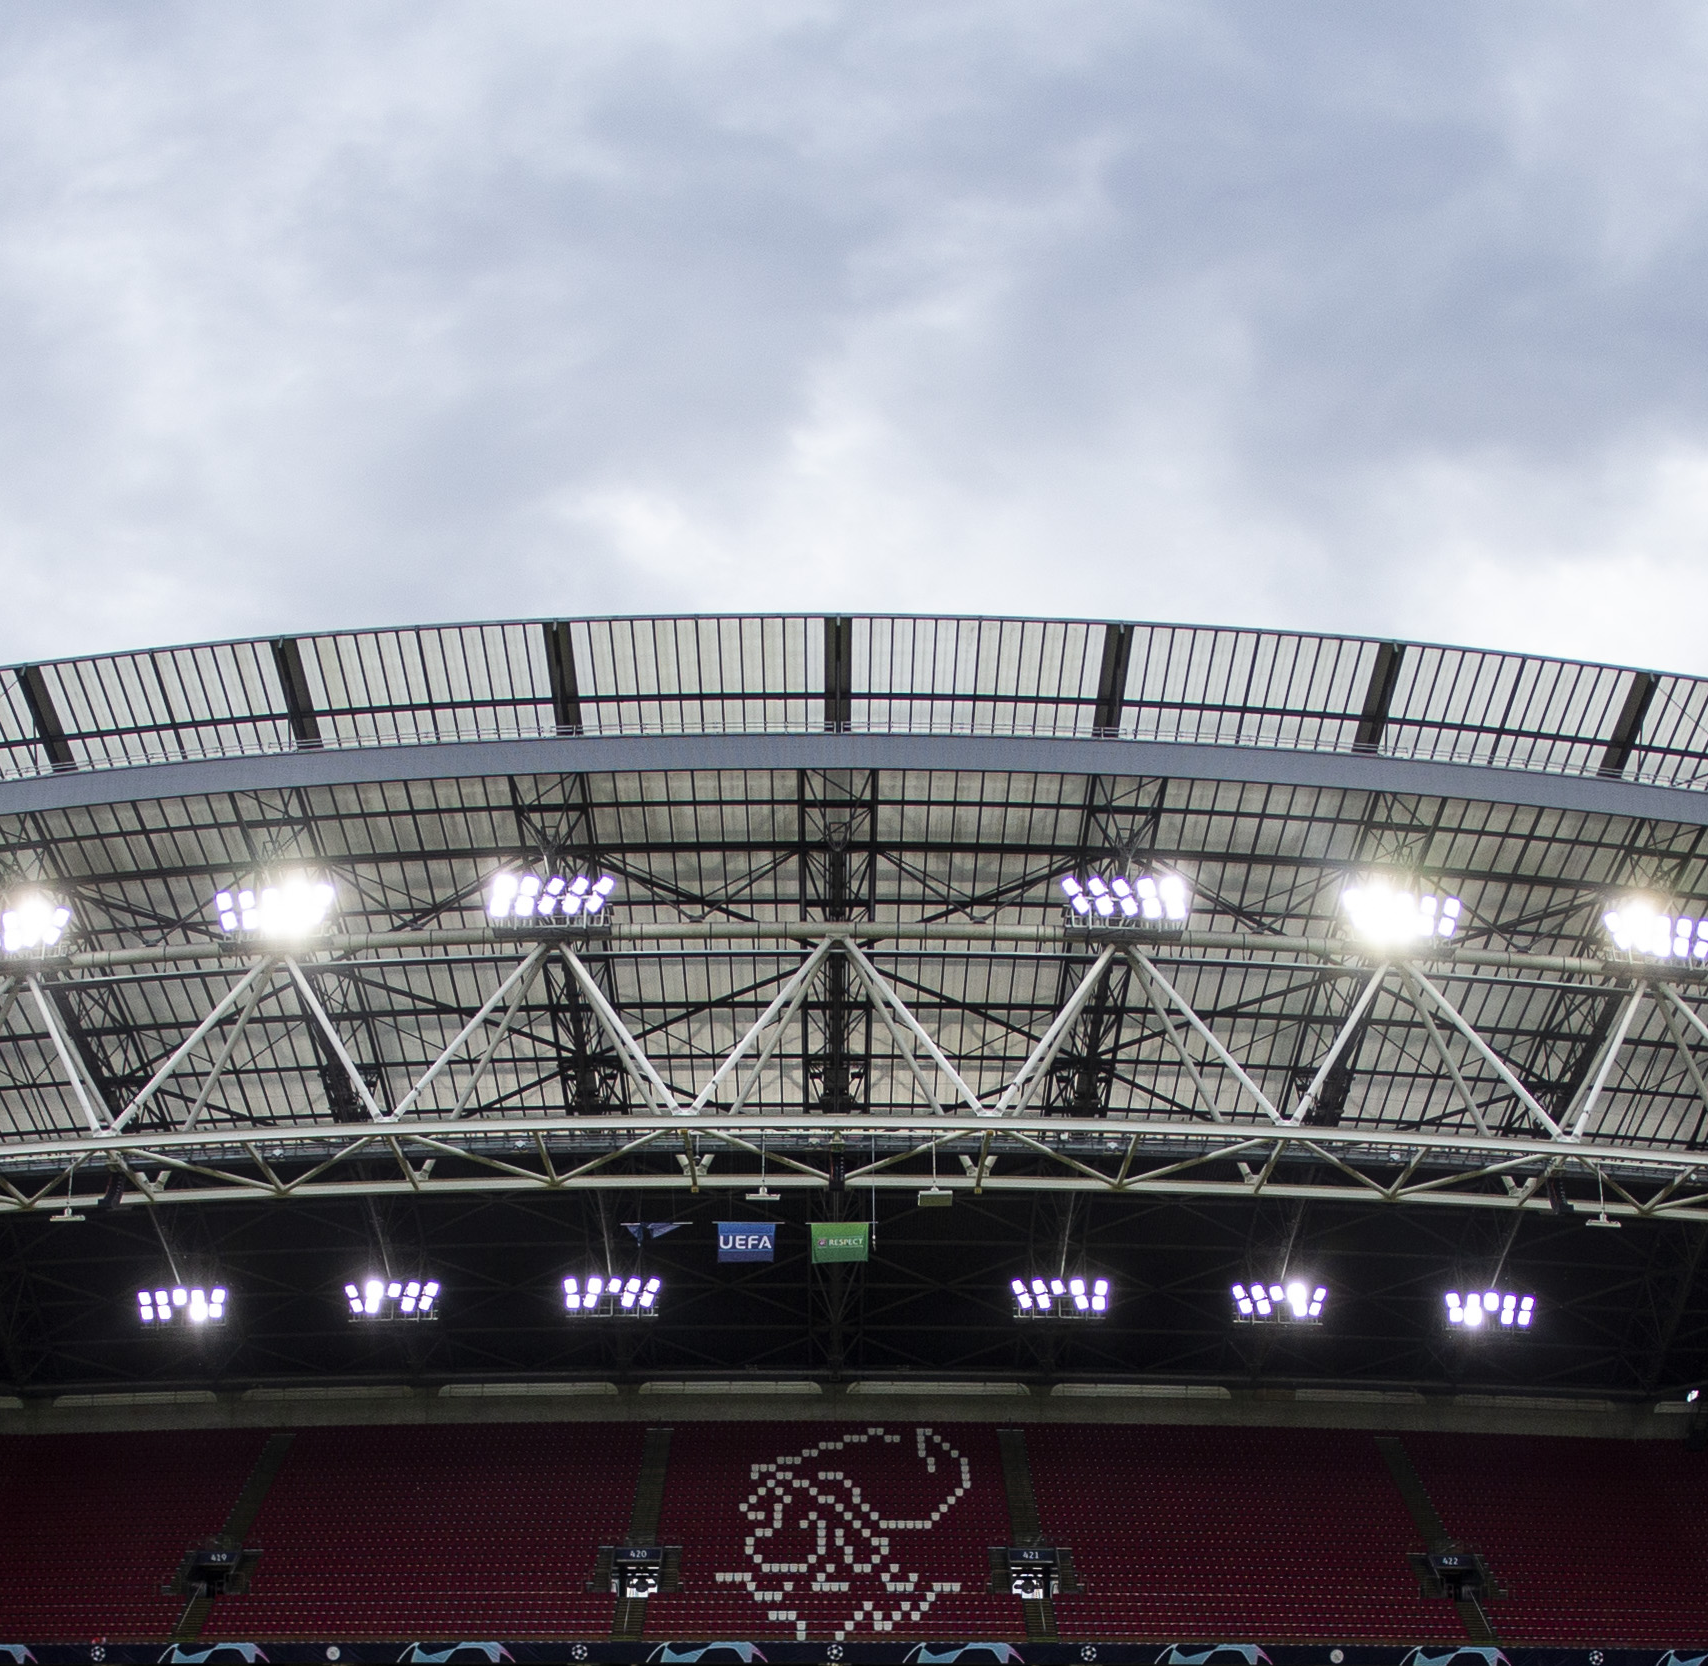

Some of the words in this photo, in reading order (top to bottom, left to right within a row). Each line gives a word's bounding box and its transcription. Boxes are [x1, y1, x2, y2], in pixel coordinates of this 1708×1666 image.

[719, 1235, 773, 1250] UEFA
[828, 1238, 864, 1247] RESPECT
[210, 1553, 228, 1562] 419
[629, 1549, 648, 1558] 420
[1022, 1551, 1040, 1559] 421
[1442, 1557, 1459, 1565] 422
